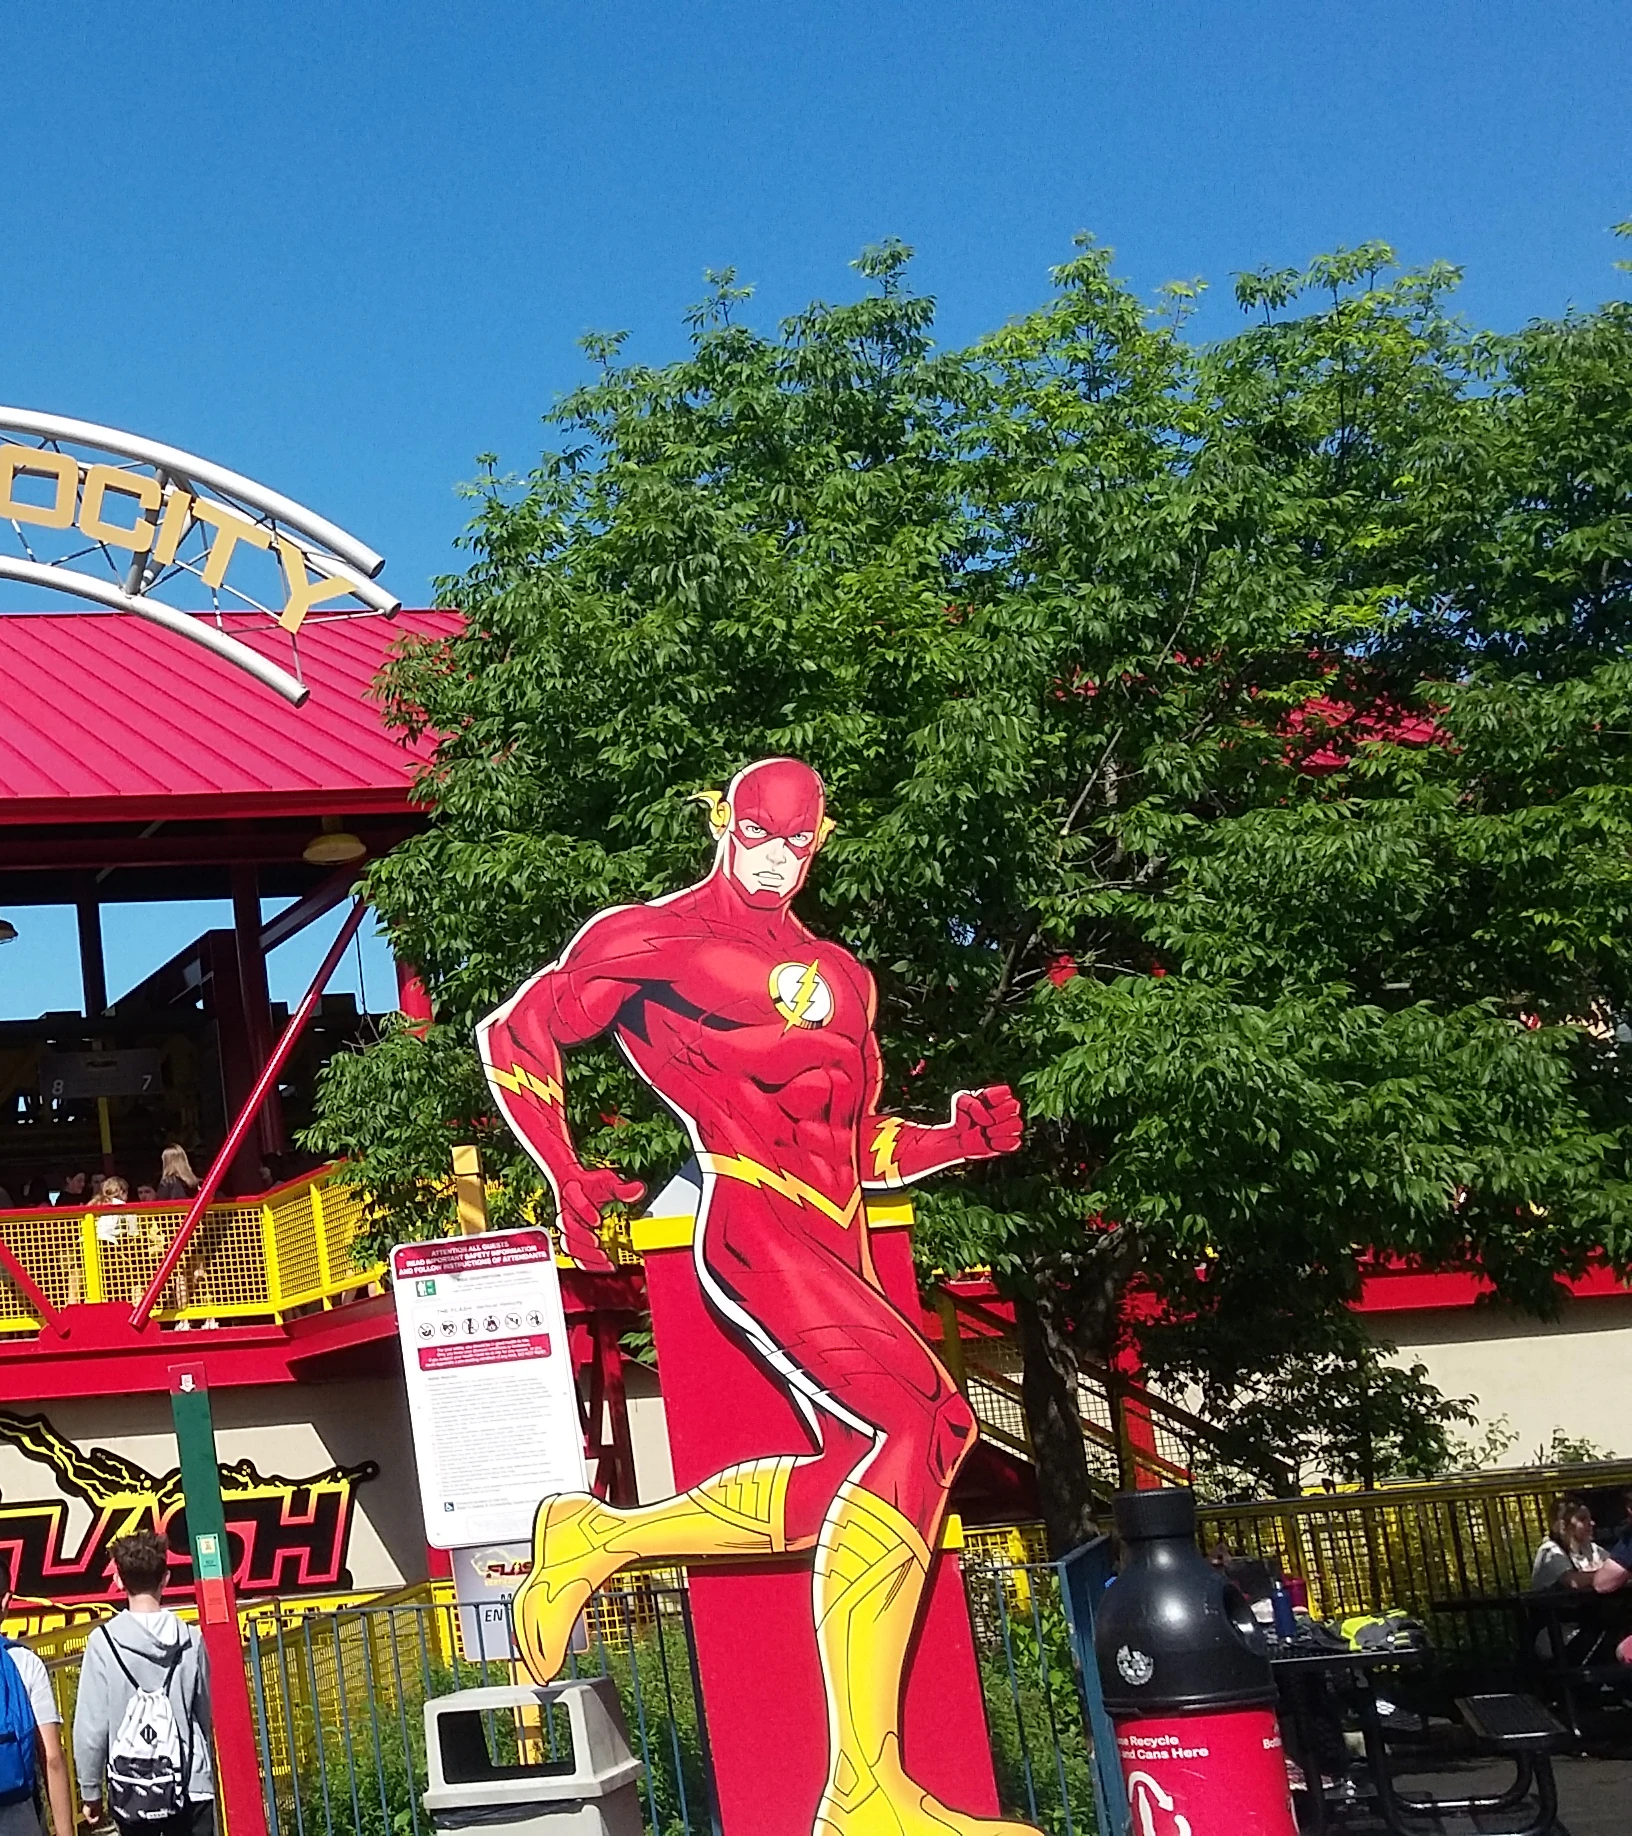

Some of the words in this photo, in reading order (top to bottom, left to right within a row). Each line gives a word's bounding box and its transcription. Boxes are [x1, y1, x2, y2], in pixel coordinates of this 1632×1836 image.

[52, 1079, 64, 1095] 8
[142, 1074, 152, 1091] 7
[426, 1254, 464, 1267] IMPORTANT
[464, 1251, 490, 1261] SAFETY
[491, 1245, 537, 1258] INFORMATION
[431, 1246, 467, 1257] ATTENTION
[468, 1244, 481, 1252] ALL
[482, 1241, 509, 1251] GUESTS
[399, 1267, 413, 1276] AND
[414, 1264, 442, 1274] FOLLOW
[443, 1257, 491, 1271] INSTRUCTIONS
[492, 1256, 502, 1264] OF
[502, 1251, 547, 1263] ATTENDANTS
[1129, 1734, 1179, 1747] Recycle
[1137, 1748, 1169, 1760] Cans
[1171, 1746, 1209, 1759] Here
